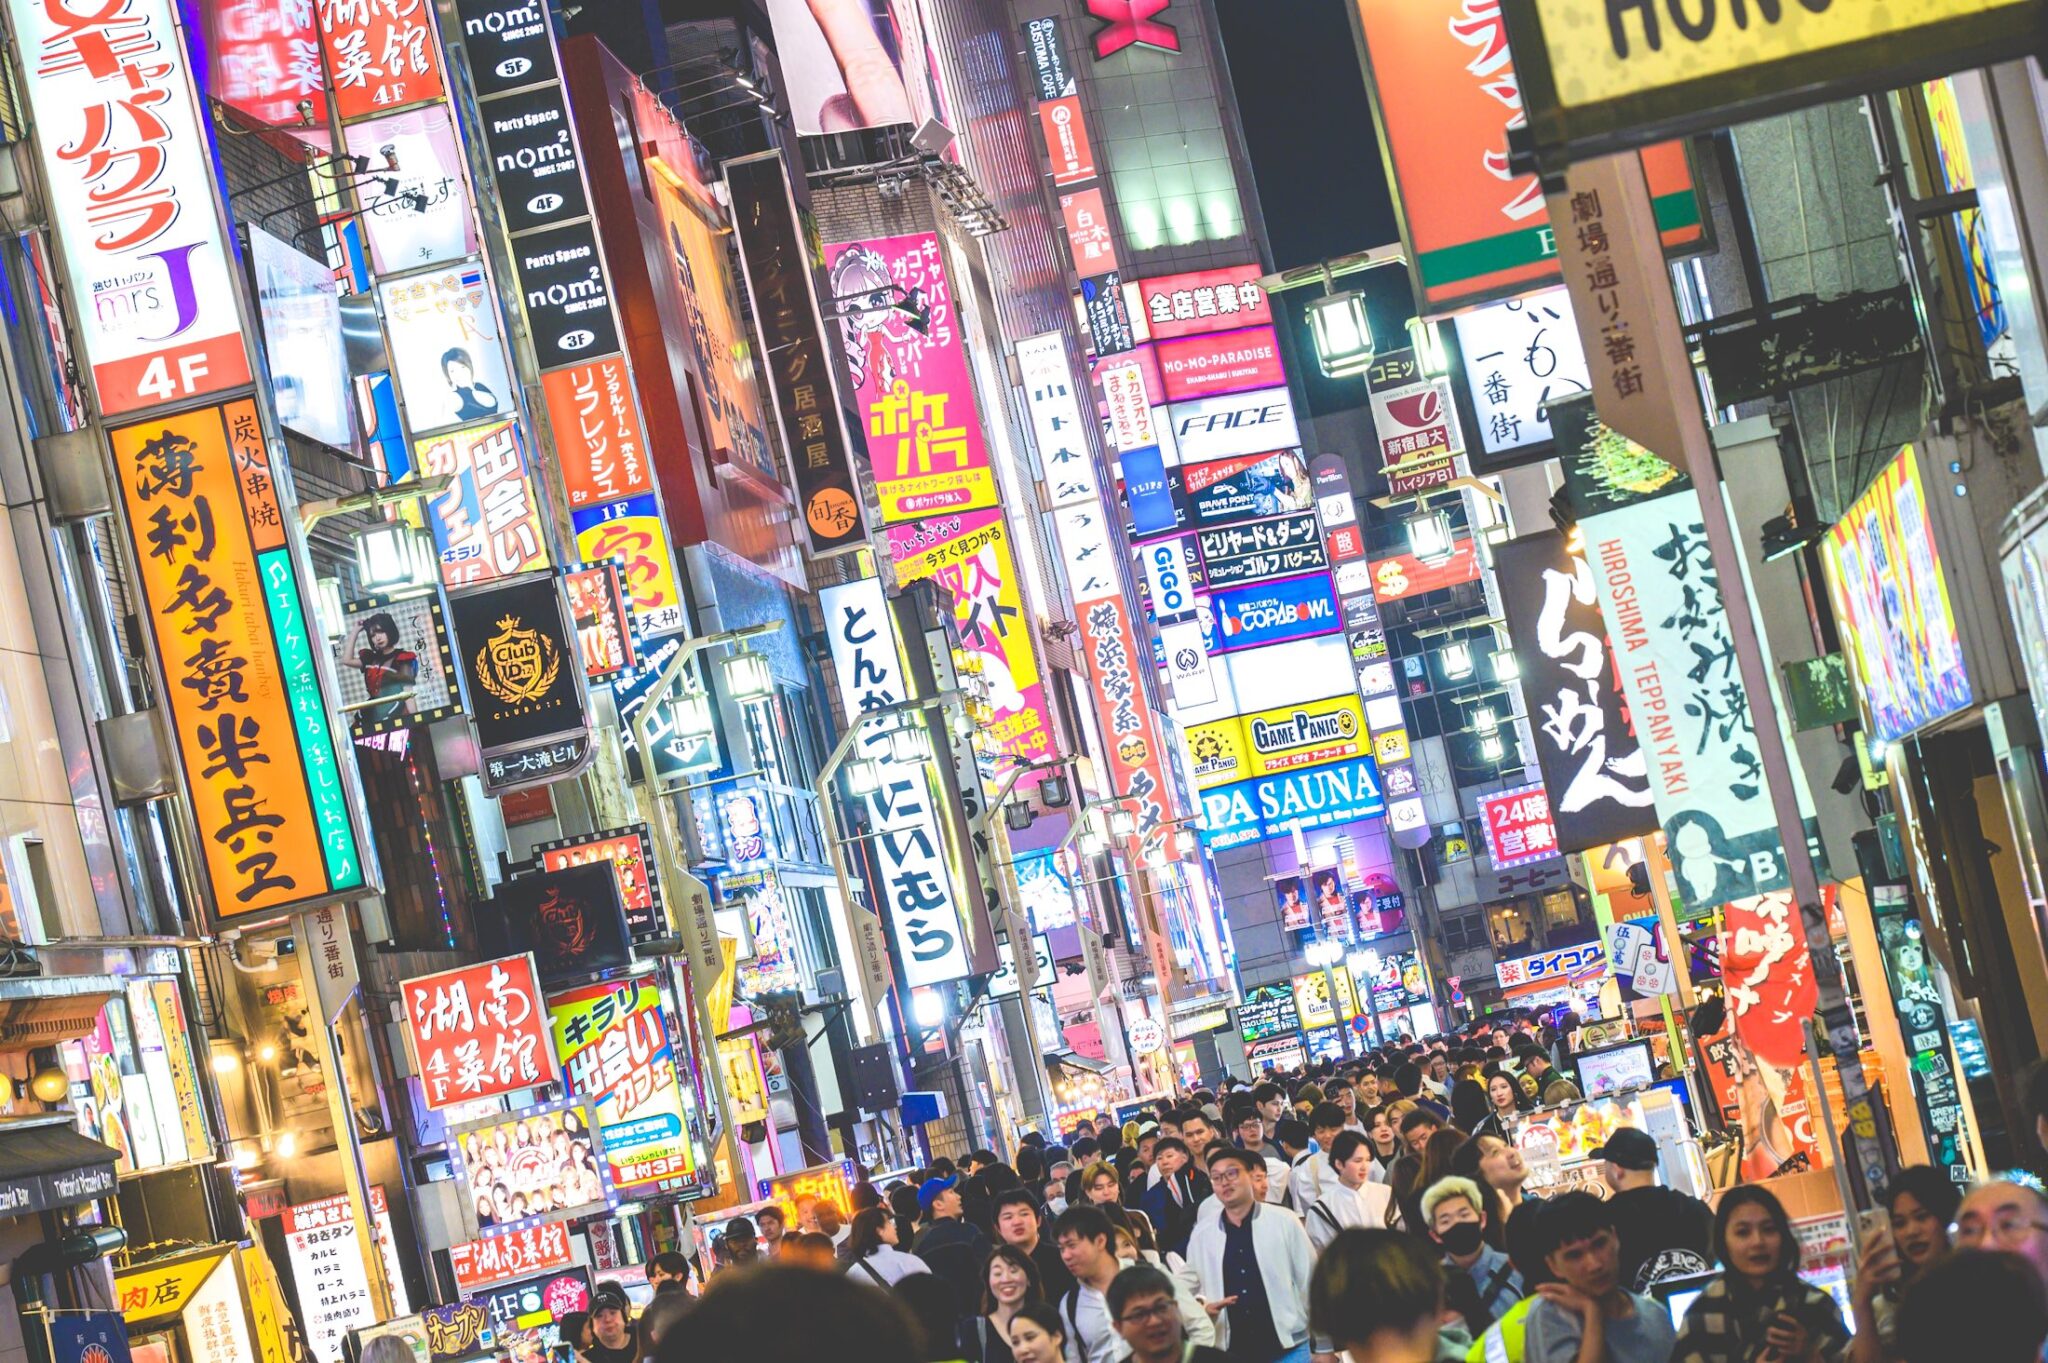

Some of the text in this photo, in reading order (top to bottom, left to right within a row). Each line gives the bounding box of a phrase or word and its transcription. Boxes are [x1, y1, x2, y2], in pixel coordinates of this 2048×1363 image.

[502, 23, 544, 42] SINCE 2007
[504, 58, 524, 75] 5F
[372, 82, 407, 106] 4F
[1041, 73, 1058, 99] CAFE
[493, 109, 559, 133] Party Space
[533, 159, 575, 177] SINCE 2007
[536, 195, 555, 212] 4F
[1075, 209, 1110, 260] 白木屋
[418, 247, 433, 260] 3F
[525, 245, 591, 270] Party Space
[921, 240, 952, 348] キャバクラ
[1105, 273, 1119, 287] 4F
[1570, 187, 1643, 401] 劇場通り一番街
[564, 295, 607, 315] SINCE 2007
[907, 250, 936, 348] コンカェ
[1149, 281, 1262, 324] 全店営業中
[1095, 300, 1112, 346] &コミック
[1101, 286, 1123, 352] インターネット
[566, 333, 586, 348] 3F
[136, 352, 210, 400] 4F
[1164, 346, 1273, 375] MO-MO-PARADISE
[1108, 375, 1134, 446] まねきねこ
[1127, 382, 1149, 432] カラオケ
[1475, 350, 1523, 444] 一番街
[570, 366, 620, 498] リフレッシュ
[601, 364, 642, 485] レンタルルーム ホステル
[1179, 403, 1288, 437] FACE
[1387, 429, 1445, 455] 新宿最大
[232, 414, 280, 529] 炭火串焼
[880, 471, 982, 497] 稼げるナイトワーク探しは
[1396, 469, 1453, 492] ハイジアB1
[426, 438, 474, 546] カフェ
[471, 428, 538, 576] 出会い
[572, 489, 588, 502] 2F
[1199, 494, 1256, 510] BRAVE POINT
[601, 501, 629, 521] 1F
[903, 516, 962, 552] いちごなび
[925, 525, 1002, 568] 今すぐ見つかる
[1201, 518, 1316, 559] ビリヤード&ダーツ
[443, 543, 484, 564] キラリ
[1244, 554, 1282, 577] ゴルフ
[1283, 550, 1324, 569] バグース
[449, 562, 482, 590] 1F
[1154, 547, 1183, 610] GiGO
[1598, 538, 1649, 653] HIROSHIMA
[641, 608, 679, 633] 天神
[496, 643, 536, 663] Club
[1087, 602, 1141, 734] 横浜家系
[1652, 522, 1762, 801] お好み焼き
[1254, 716, 1300, 750] GAME
[489, 745, 583, 778] 第一大滝ビル
[1211, 757, 1237, 772] PANIC
[1265, 756, 1291, 770] プライズ
[1292, 751, 1312, 764] ビデオ
[1258, 762, 1381, 823] SAUNA
[1499, 822, 1557, 857] 営業
[315, 908, 346, 981] 通り一番街
[414, 964, 533, 1042] 湖南
[565, 979, 641, 1046] キラリ
[567, 1010, 662, 1100] 出会い
[613, 1058, 674, 1119] カフェ
[618, 1152, 688, 1184] 受付3F
[307, 1224, 355, 1246] ねぎタン
[310, 1247, 338, 1261] カルビ
[313, 1262, 342, 1277] ハラミ
[455, 1262, 471, 1277] 4F
[317, 1278, 345, 1292] ロース
[320, 1289, 367, 1308] 特上ハラミ
[487, 1288, 520, 1321] 4F
[426, 1303, 490, 1352] オープン
